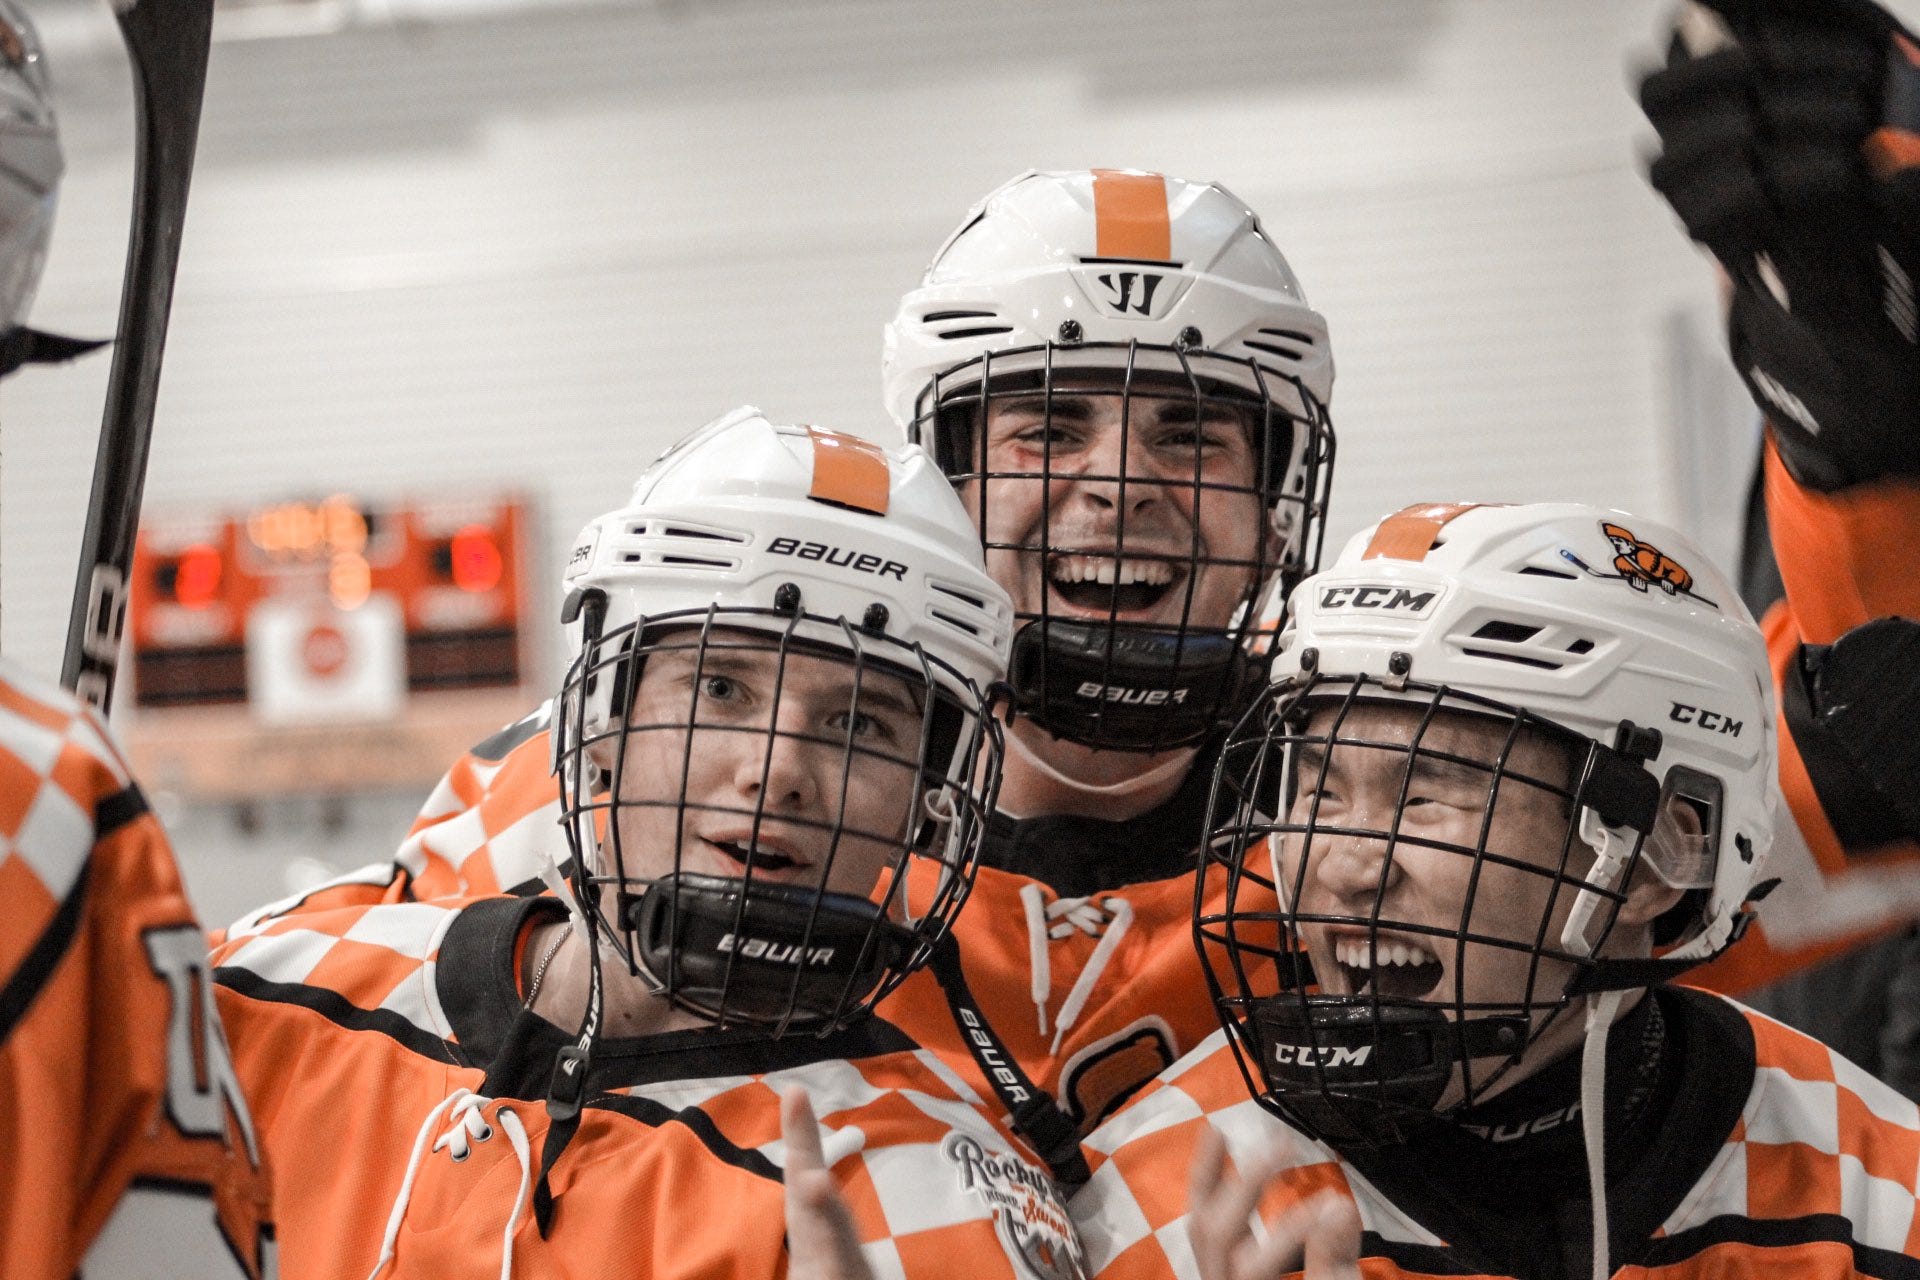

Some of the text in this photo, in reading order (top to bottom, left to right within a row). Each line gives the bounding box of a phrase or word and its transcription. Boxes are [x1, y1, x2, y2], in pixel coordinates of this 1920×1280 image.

[765, 537, 909, 582] BAUER
[1321, 587, 1437, 612] CCM
[1669, 701, 1744, 738] CCM
[1275, 1042, 1373, 1067] CCM
